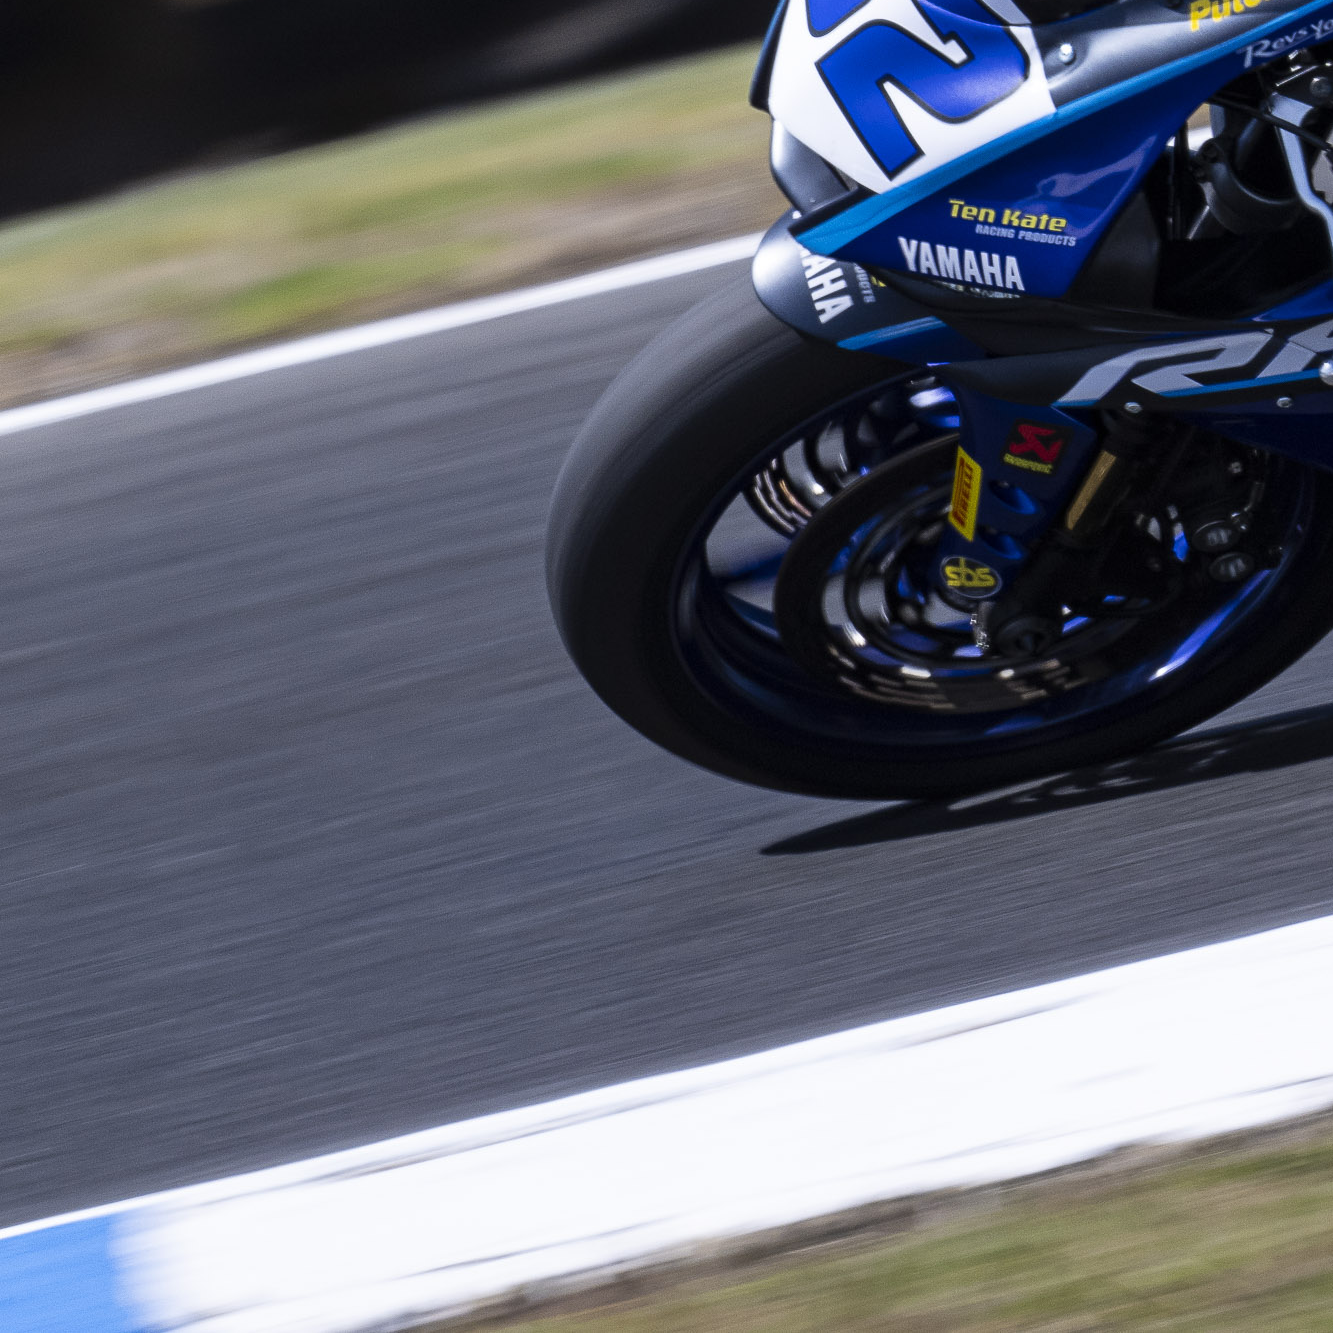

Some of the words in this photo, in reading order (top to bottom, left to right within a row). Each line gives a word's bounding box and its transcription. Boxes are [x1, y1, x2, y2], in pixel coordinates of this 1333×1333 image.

[1235, 27, 1309, 69] Revs
[948, 197, 995, 224] Ten
[1001, 208, 1067, 233] Kate
[975, 223, 1016, 239] RACING
[1018, 228, 1077, 247] PRODUCTS
[897, 235, 1025, 291] YAMAHA
[796, 246, 854, 324] AHA
